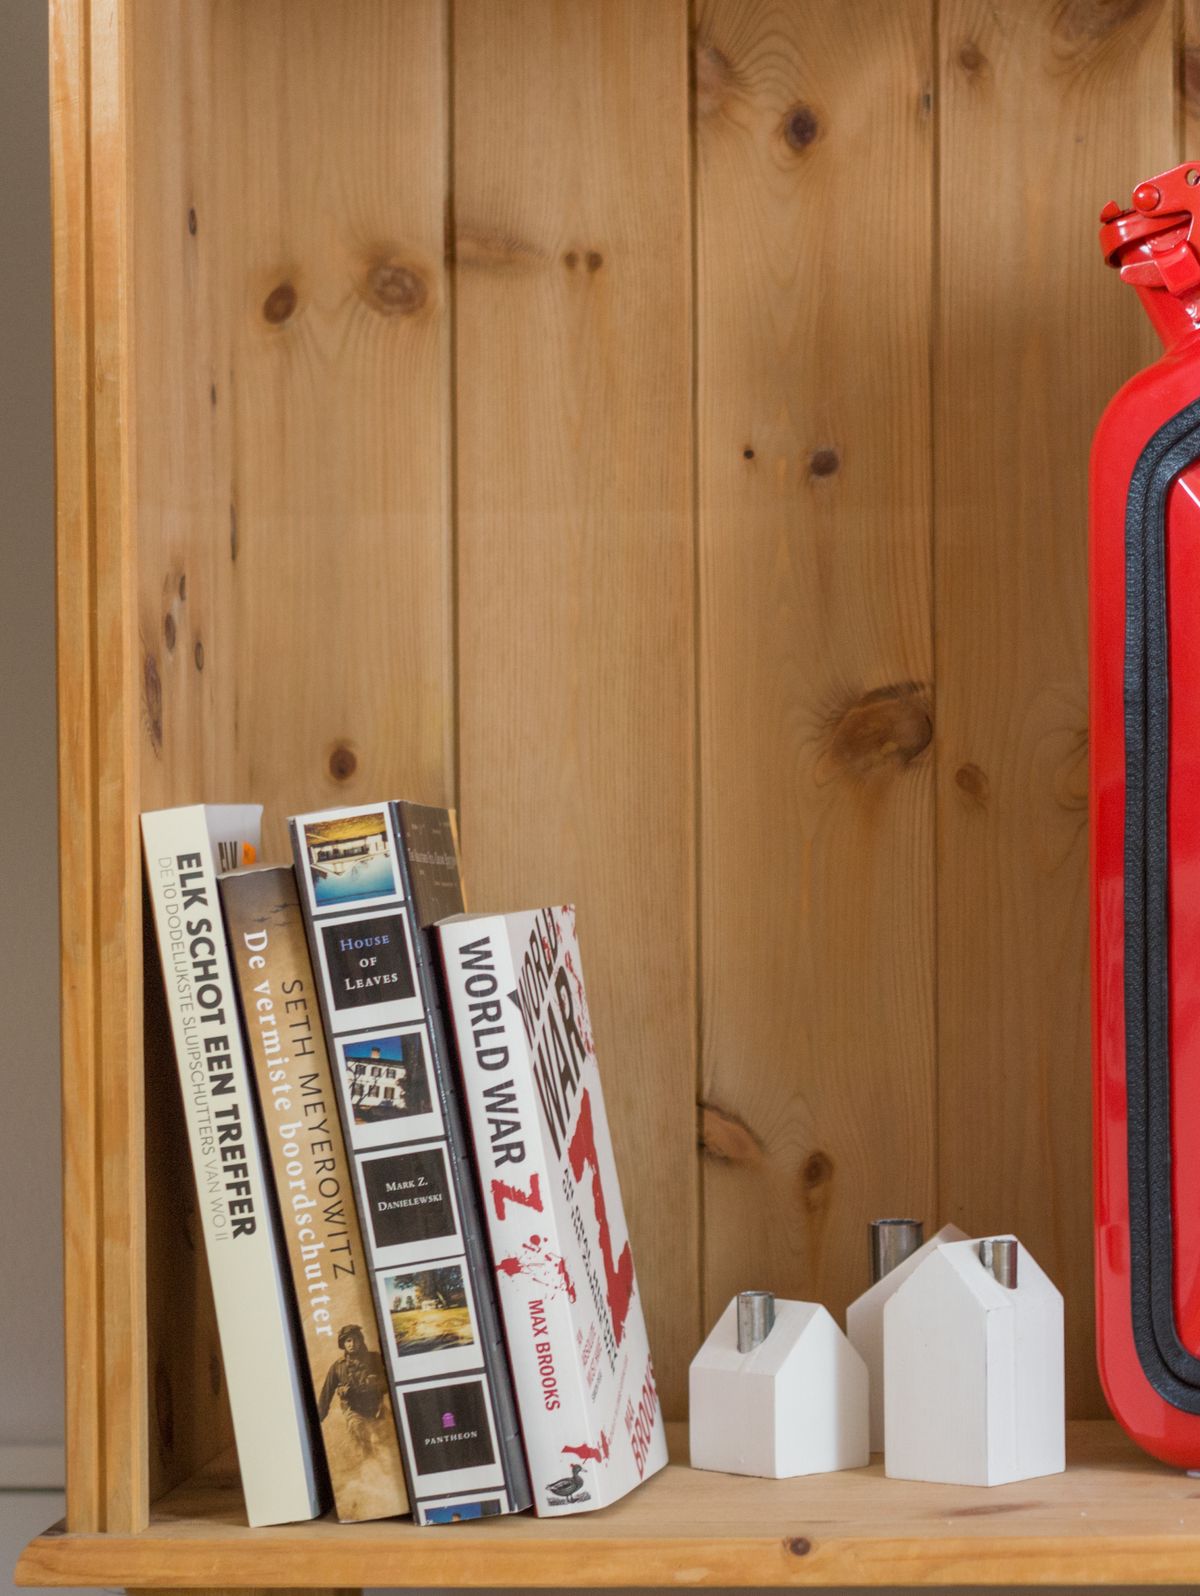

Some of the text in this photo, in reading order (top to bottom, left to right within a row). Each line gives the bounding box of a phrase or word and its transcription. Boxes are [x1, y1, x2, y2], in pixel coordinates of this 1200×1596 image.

[158, 856, 175, 879] DE
[162, 883, 177, 899] 10
[165, 903, 194, 1012] DODELIJKSTE
[507, 907, 559, 1050] WORLD
[176, 852, 257, 1239] ELK SCHOT EEN TREFFER
[182, 1017, 216, 1156] SLUIPSCHUTTERS
[458, 936, 544, 1221] WORLD WAR Z
[533, 965, 587, 1162] WAR
[203, 1159, 221, 1194] VAN
[243, 928, 334, 1337] De vermiste boordschutter
[281, 979, 356, 1281] SETH MEYEROWITZ
[210, 1197, 227, 1229] WO
[528, 1299, 561, 1412] MAX BROOKS
[424, 1430, 478, 1446] PANTHEON
